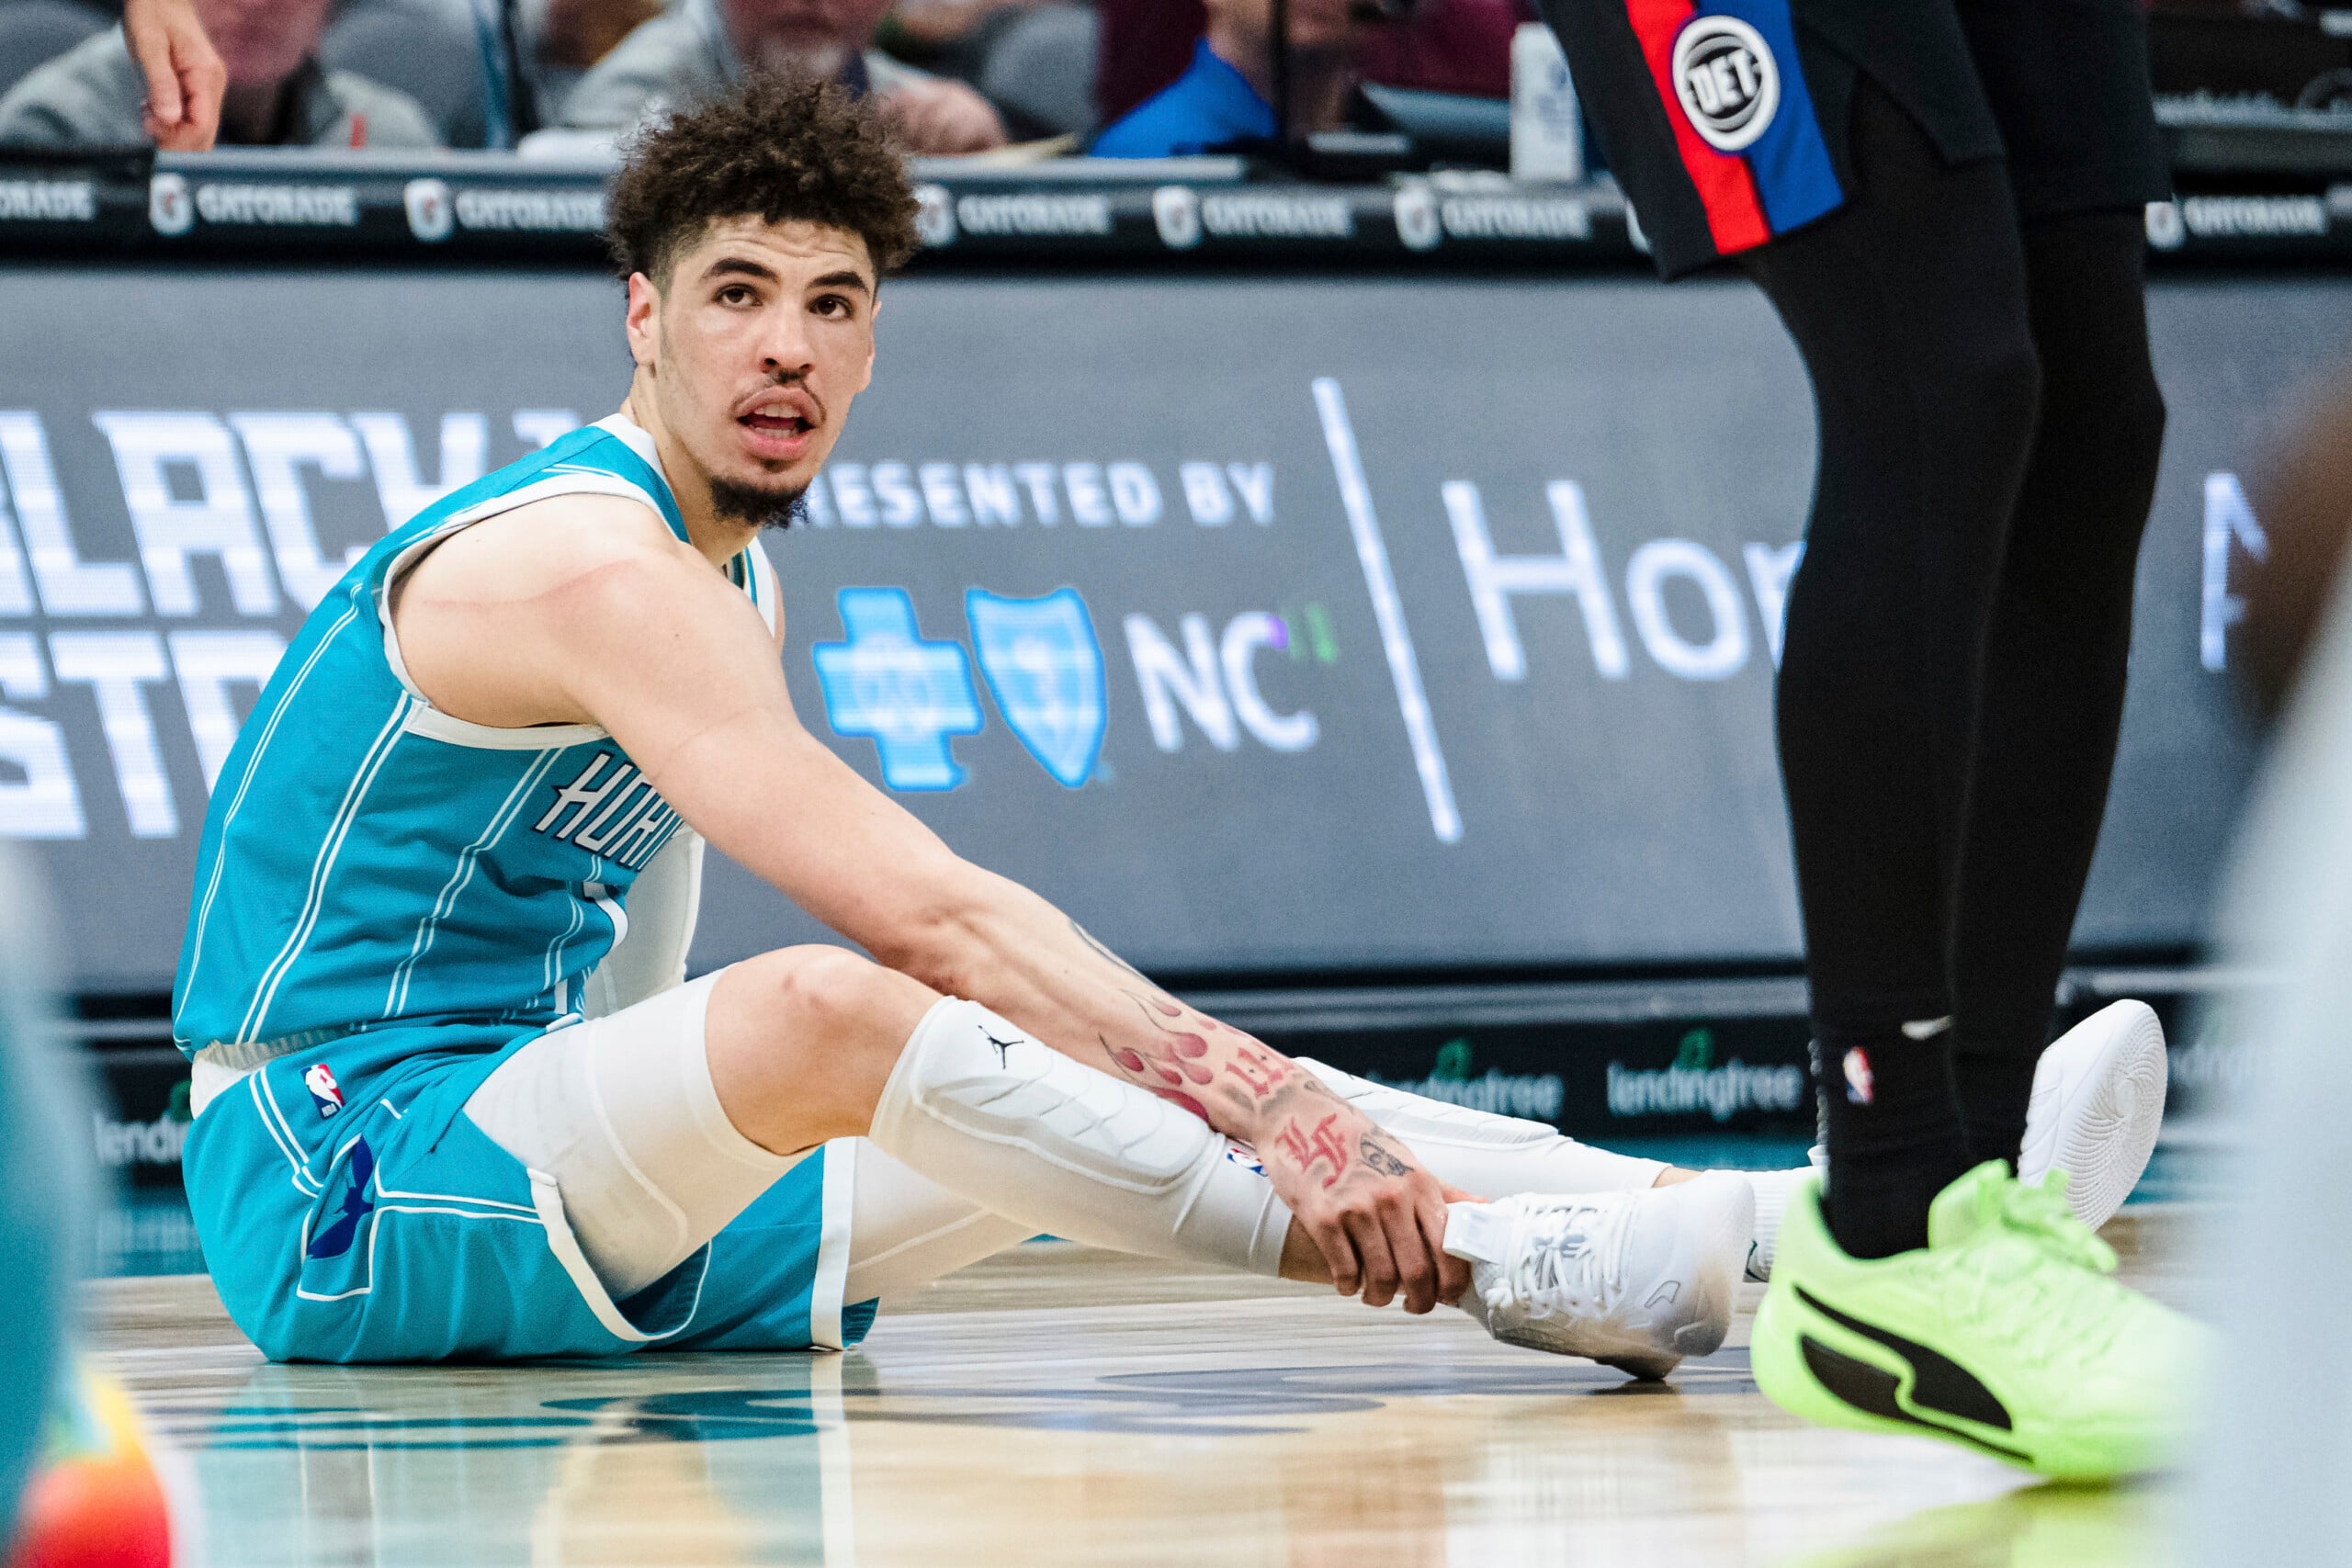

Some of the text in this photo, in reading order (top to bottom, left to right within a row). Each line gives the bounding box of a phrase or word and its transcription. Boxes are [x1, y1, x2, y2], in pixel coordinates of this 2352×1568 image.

[1687, 50, 1758, 115] DET
[197, 185, 356, 227] GATORADE
[1181, 462, 1274, 526] BY
[1123, 613, 1320, 750] NC
